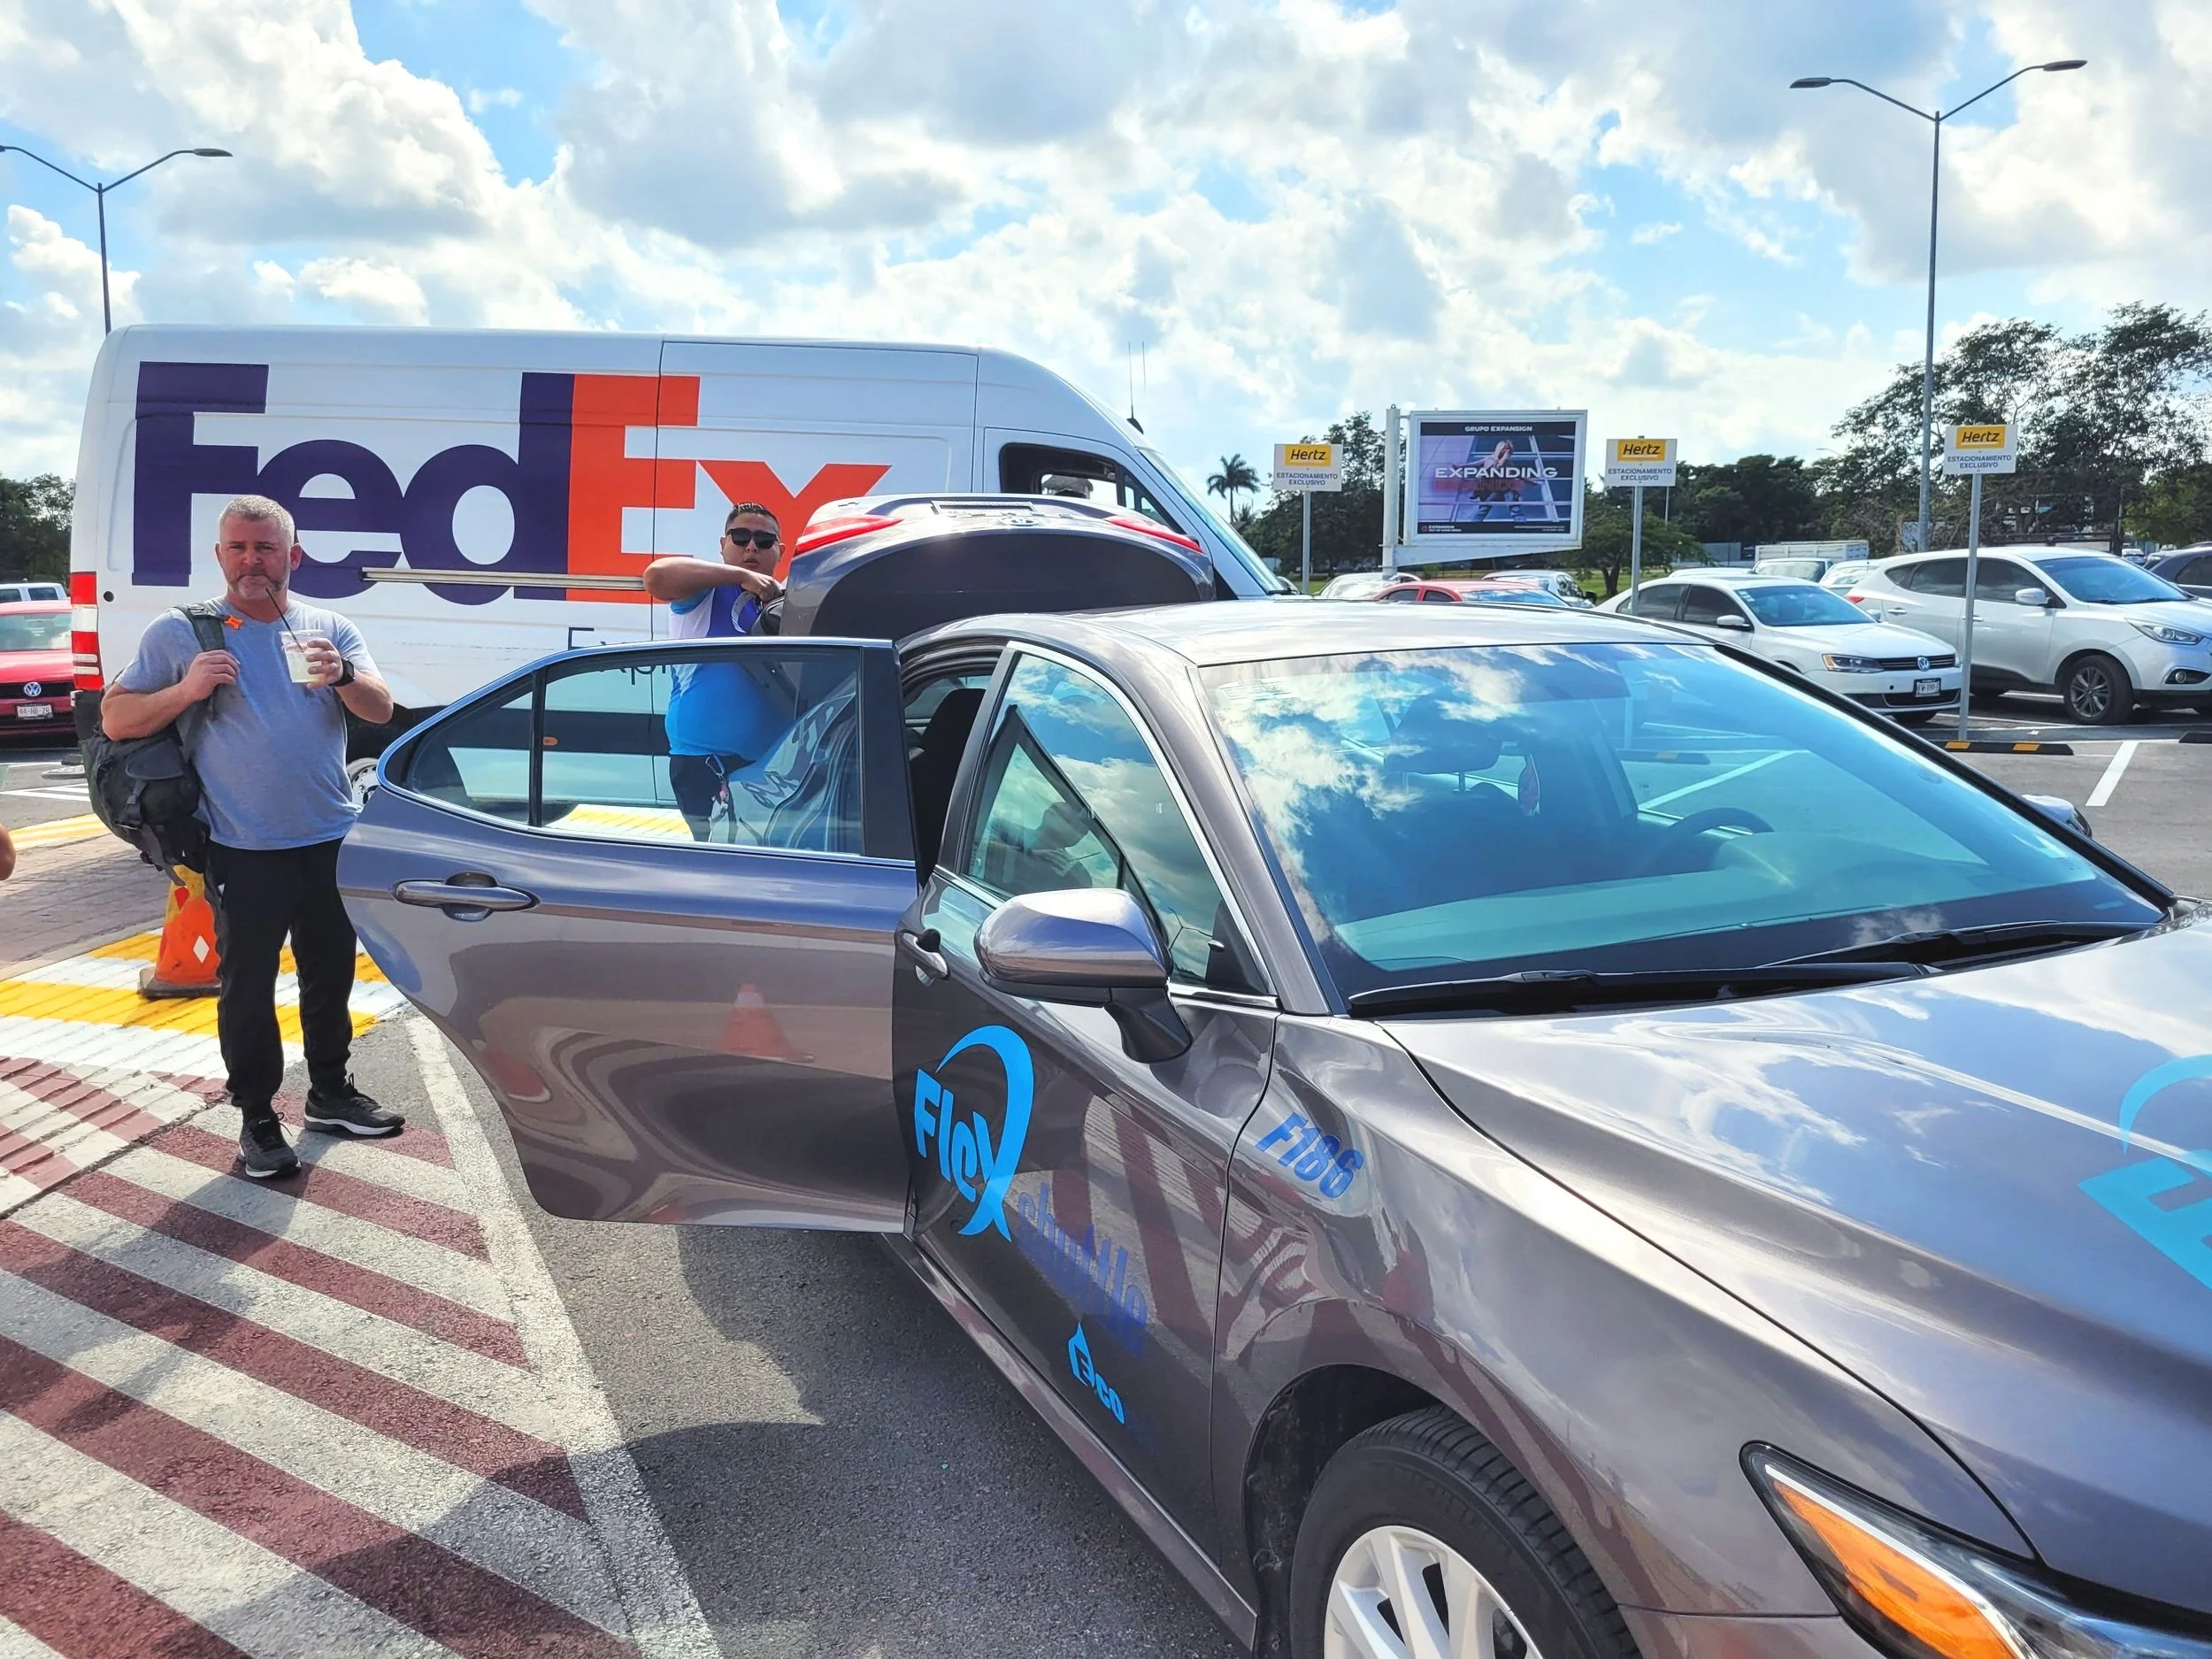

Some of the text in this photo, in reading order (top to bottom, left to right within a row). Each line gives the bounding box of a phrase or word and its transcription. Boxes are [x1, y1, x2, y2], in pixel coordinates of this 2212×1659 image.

[1962, 431, 2001, 442] Hertz
[1290, 449, 1326, 460] Hertz
[1623, 443, 1661, 455] Hertz
[1434, 466, 1559, 479] EXPANDING
[1255, 1111, 1363, 1199] F186
